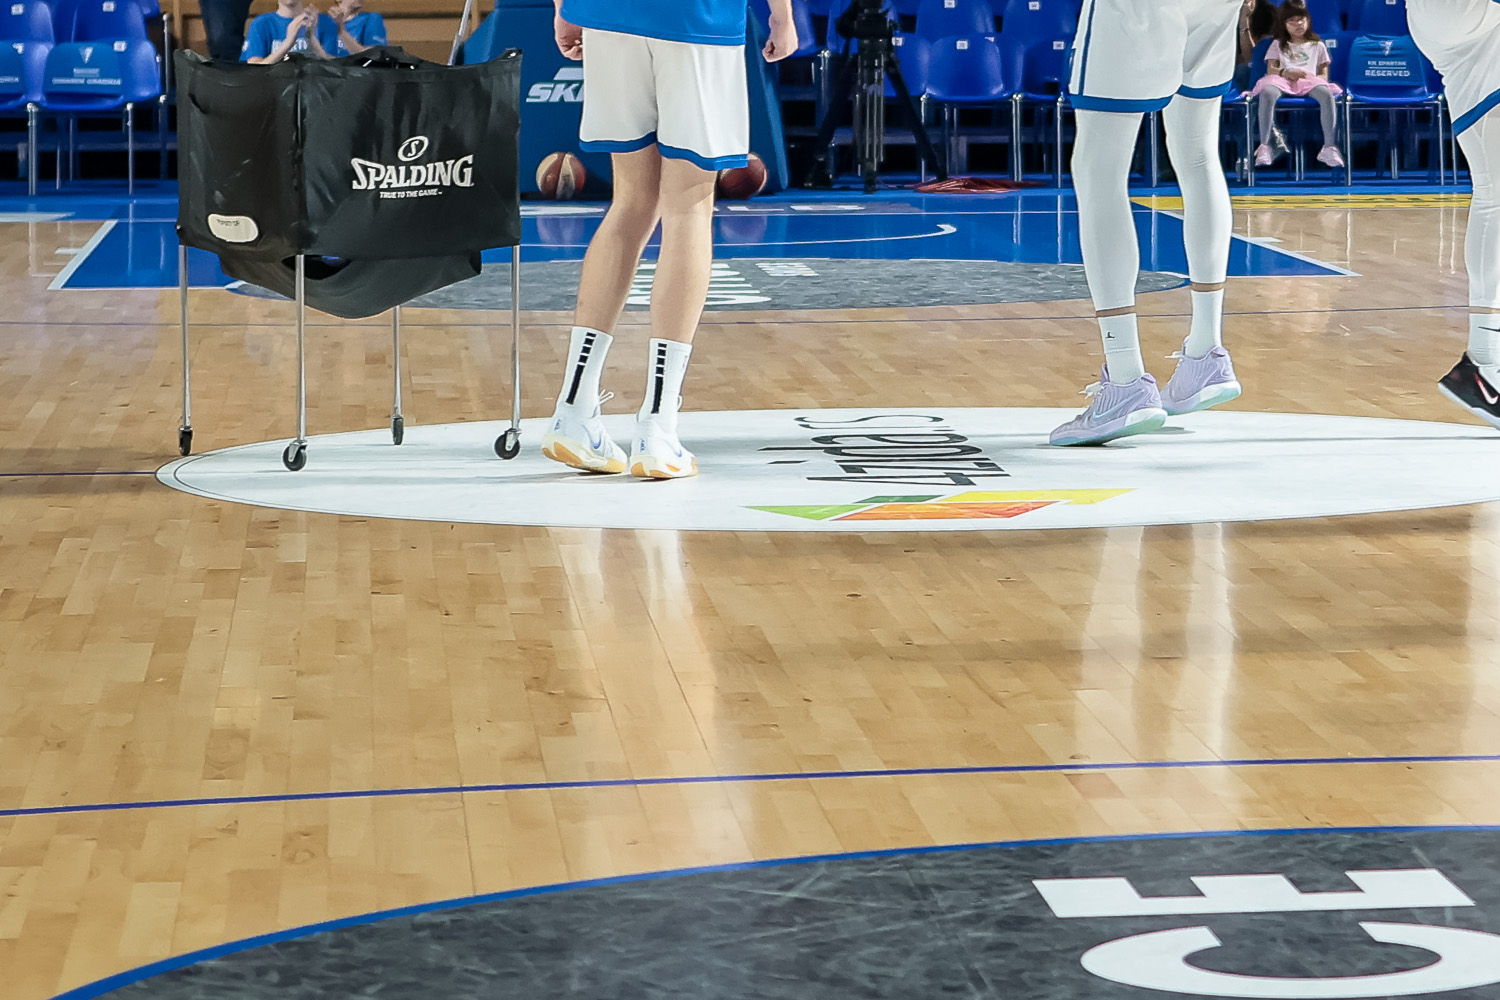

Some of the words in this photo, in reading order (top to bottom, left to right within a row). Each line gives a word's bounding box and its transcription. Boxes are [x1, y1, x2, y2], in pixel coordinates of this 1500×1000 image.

[1364, 69, 1411, 77] RESERVED
[350, 154, 474, 190] SPALDING
[379, 191, 396, 199] TRUE
[397, 191, 406, 199] TO
[406, 190, 418, 198] THE
